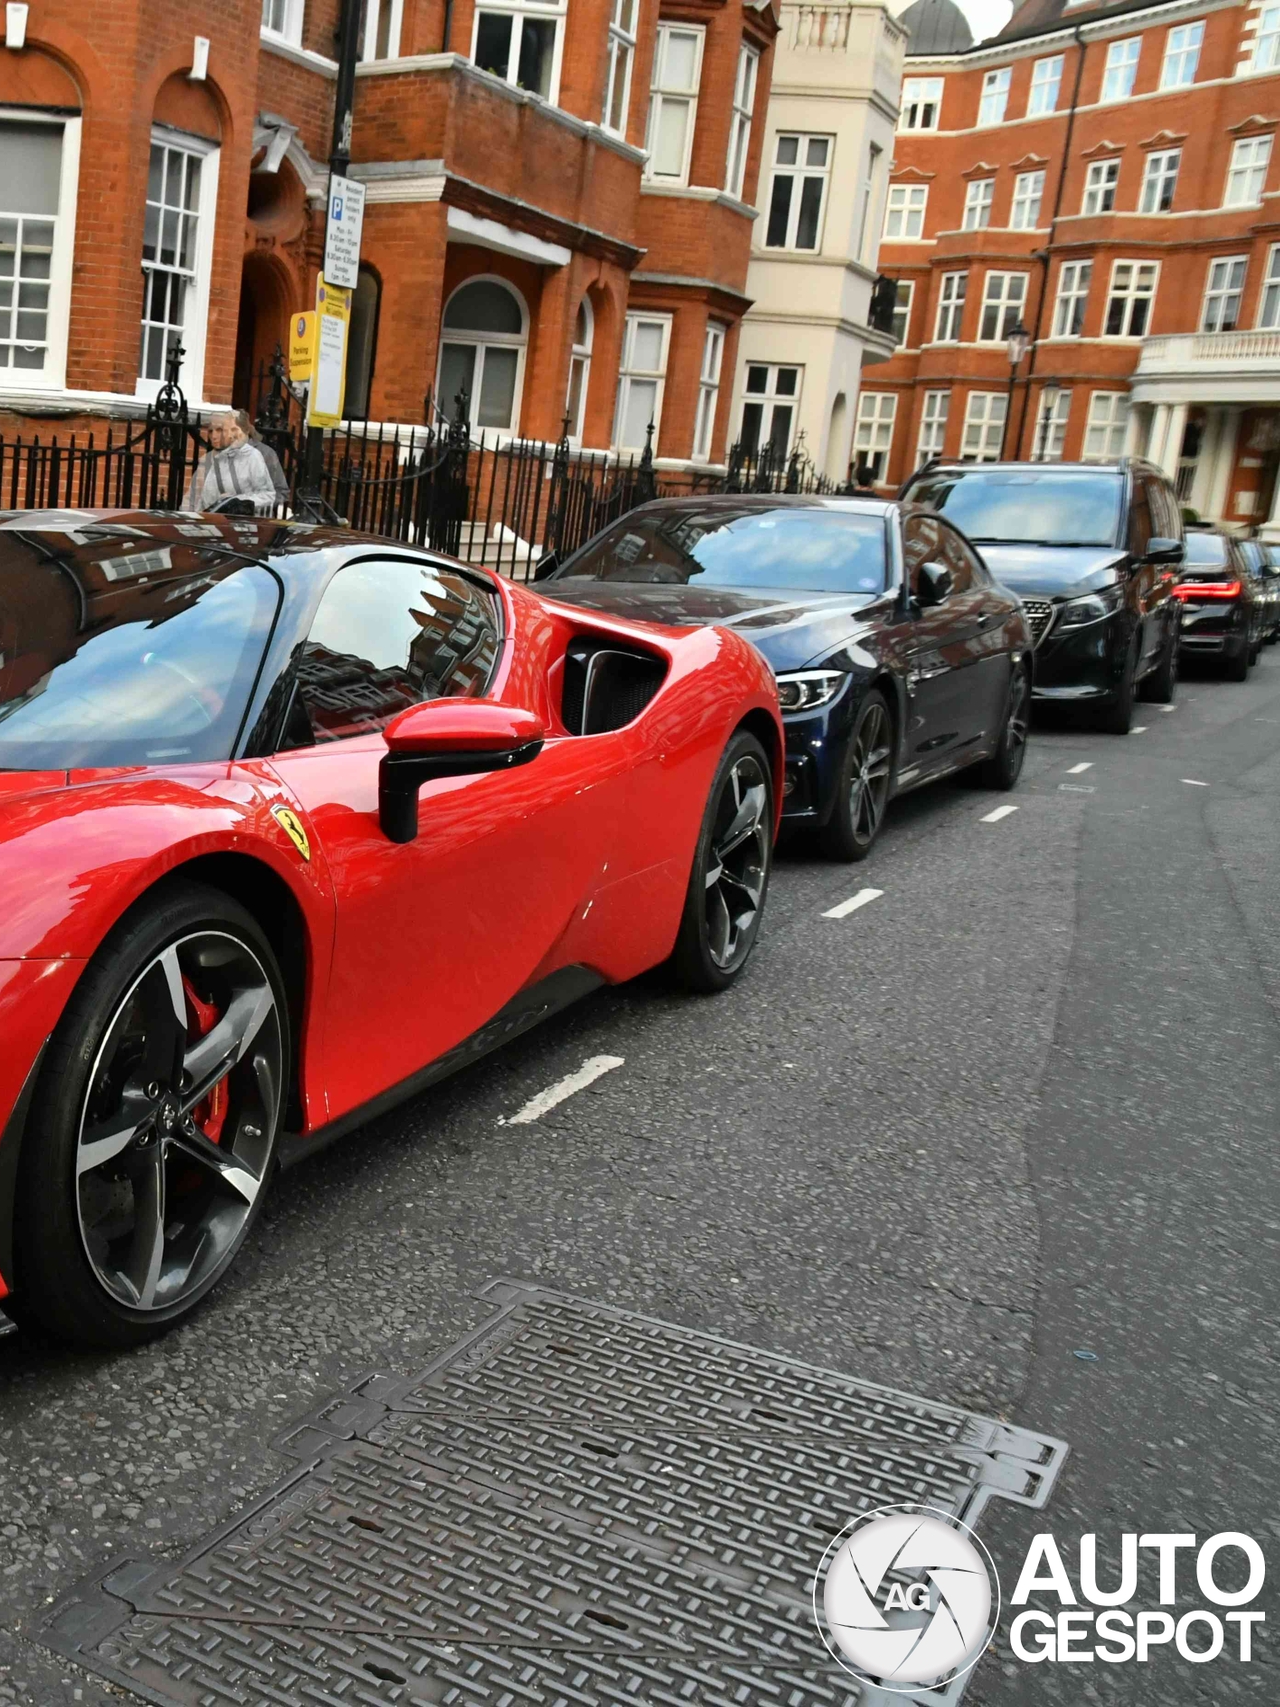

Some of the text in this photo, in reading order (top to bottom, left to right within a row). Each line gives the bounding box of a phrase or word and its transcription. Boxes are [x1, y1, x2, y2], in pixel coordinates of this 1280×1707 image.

[332, 197, 342, 219] P
[334, 244, 352, 255] Saturday
[334, 263, 349, 275] Sunday
[293, 346, 309, 355] Parking
[290, 358, 312, 367] Suspension
[450, 1320, 524, 1370] TELECOM
[223, 1481, 330, 1551] TELECOM
